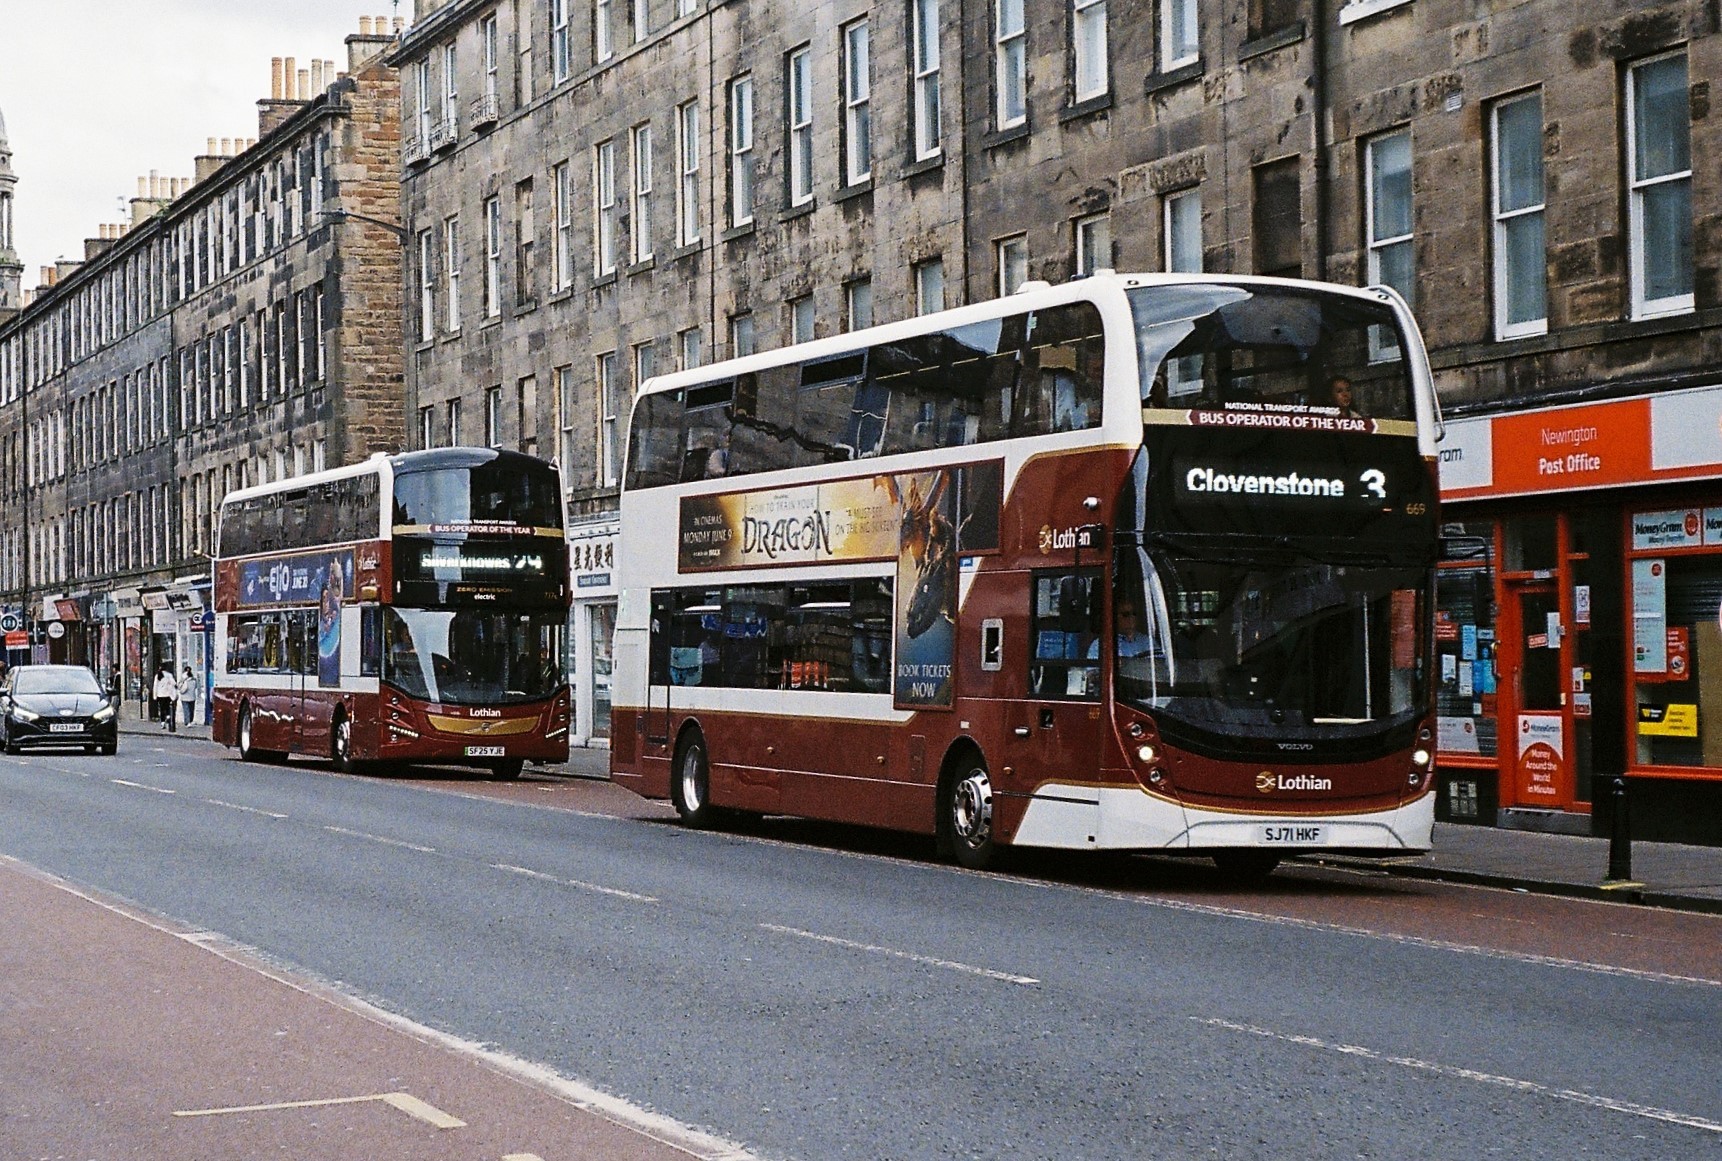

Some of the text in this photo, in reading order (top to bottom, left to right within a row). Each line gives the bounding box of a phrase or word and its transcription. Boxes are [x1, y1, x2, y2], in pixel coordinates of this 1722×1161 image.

[1224, 402, 1341, 415] NATIONAL TRANSPORT AWARDS
[1200, 412, 1366, 431] BUS OPERATOR OF THE YEAR
[1541, 426, 1598, 448] Newington
[1538, 454, 1601, 475] Post Office
[1186, 467, 1387, 500] Clovenstone 3
[683, 530, 711, 544] MONDAY
[712, 529, 727, 545] JUNE
[741, 509, 833, 559] DRAGON
[1053, 527, 1091, 549] Lothan
[898, 664, 951, 678] BOOK TICKETS
[912, 682, 936, 698] NOW
[469, 707, 501, 717] Lothian
[1278, 774, 1332, 791] Lothian
[1265, 827, 1320, 841] SJ71 HKF
